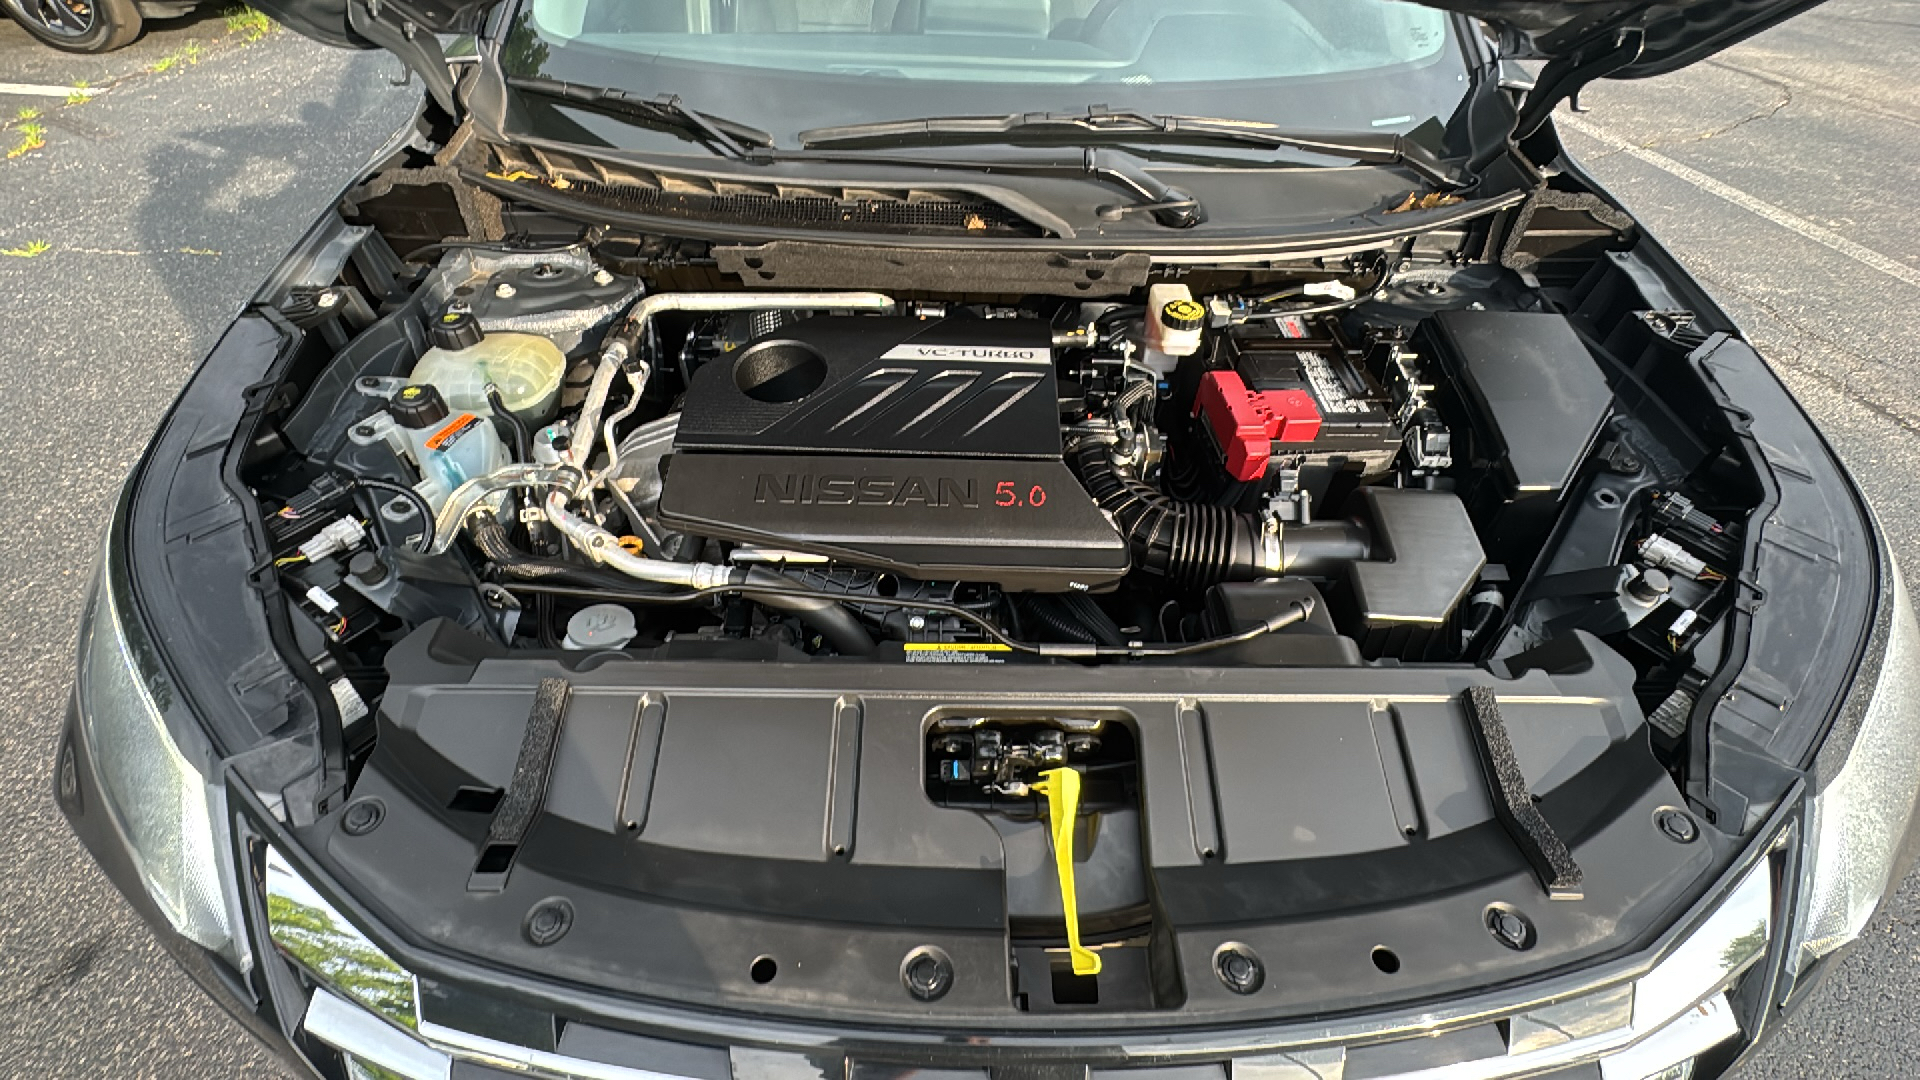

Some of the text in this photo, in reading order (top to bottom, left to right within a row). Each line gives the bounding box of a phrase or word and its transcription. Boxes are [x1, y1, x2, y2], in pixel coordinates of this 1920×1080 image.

[917, 347, 1035, 360] VC-TURBO
[754, 473, 980, 509] NISSAN
[995, 481, 1047, 508] 5.0
